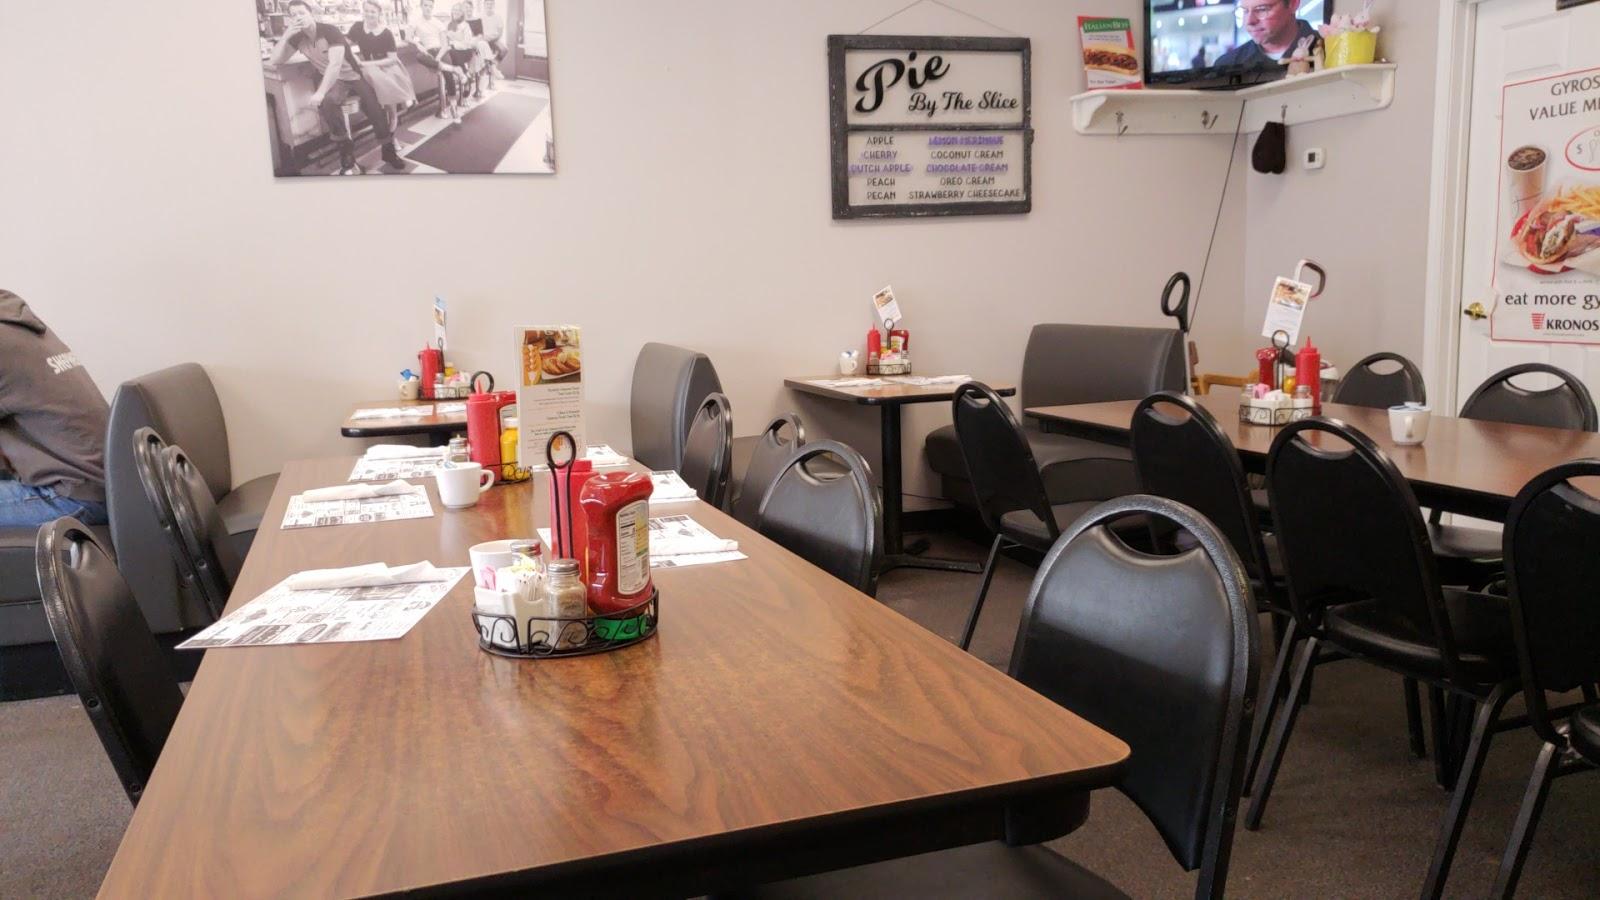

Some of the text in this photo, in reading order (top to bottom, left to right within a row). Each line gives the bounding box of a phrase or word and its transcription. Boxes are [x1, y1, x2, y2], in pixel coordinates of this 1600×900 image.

[855, 51, 951, 113] Pie
[1550, 75, 1600, 96] GYROS
[908, 91, 1018, 118] By The Slice
[1530, 101, 1577, 120] VALUE
[866, 136, 894, 145] APPLE
[863, 150, 898, 159] CHERRY
[931, 150, 1004, 159] COCONUT CREAM
[882, 164, 911, 173] APPLE
[978, 163, 1009, 172] CREAM
[867, 178, 896, 187] PEACH
[940, 176, 995, 186] OREO CREAM
[867, 191, 896, 200] PECAN
[908, 189, 1021, 200] STRAWBERRY CHEESECAKE
[1505, 291, 1529, 306] eat
[1534, 294, 1577, 306] more
[1546, 319, 1600, 331] KRONOS
